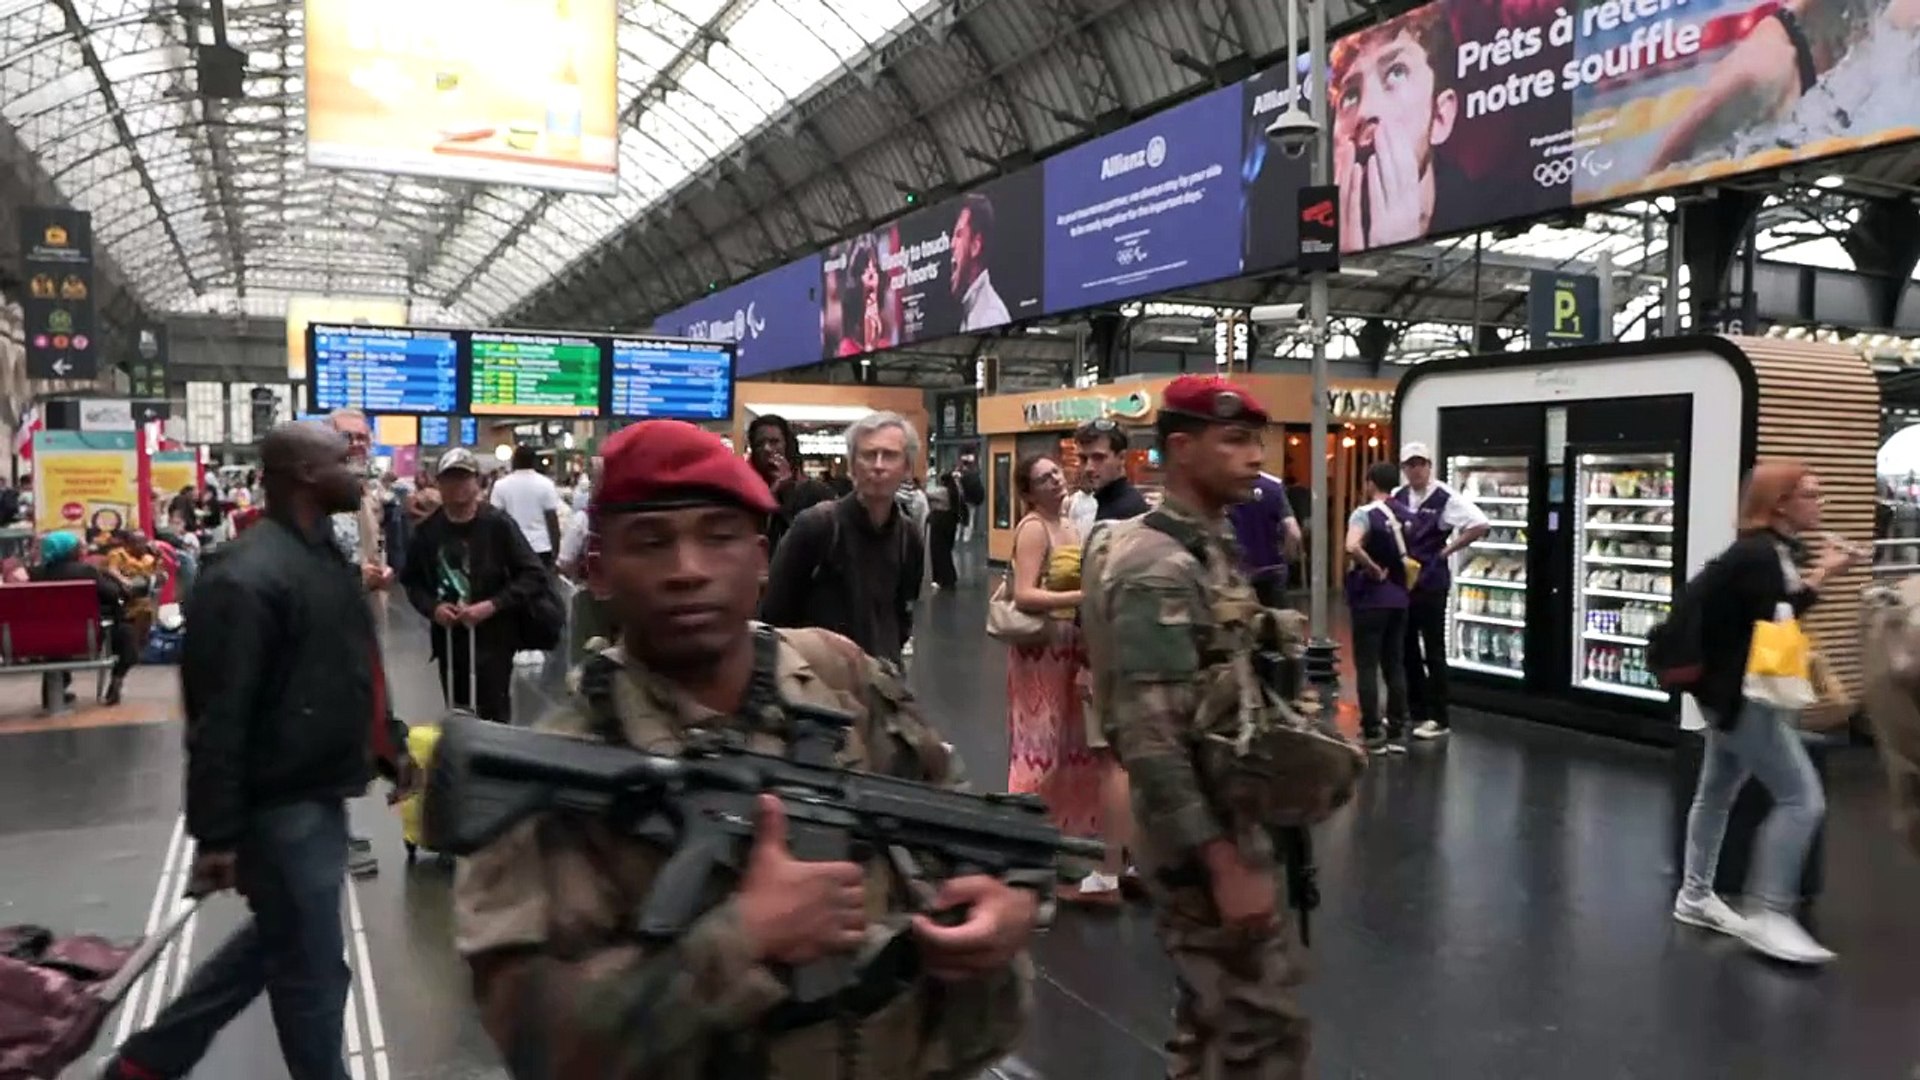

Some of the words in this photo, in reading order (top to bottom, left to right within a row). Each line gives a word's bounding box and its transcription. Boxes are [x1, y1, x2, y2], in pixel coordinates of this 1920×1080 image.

[1457, 26, 1542, 78] Prêts
[1549, 7, 1573, 47] à
[1466, 69, 1555, 118] notre
[1562, 18, 1701, 90] souffle
[1253, 85, 1302, 116] Alliaz
[1101, 150, 1146, 180] Allianz
